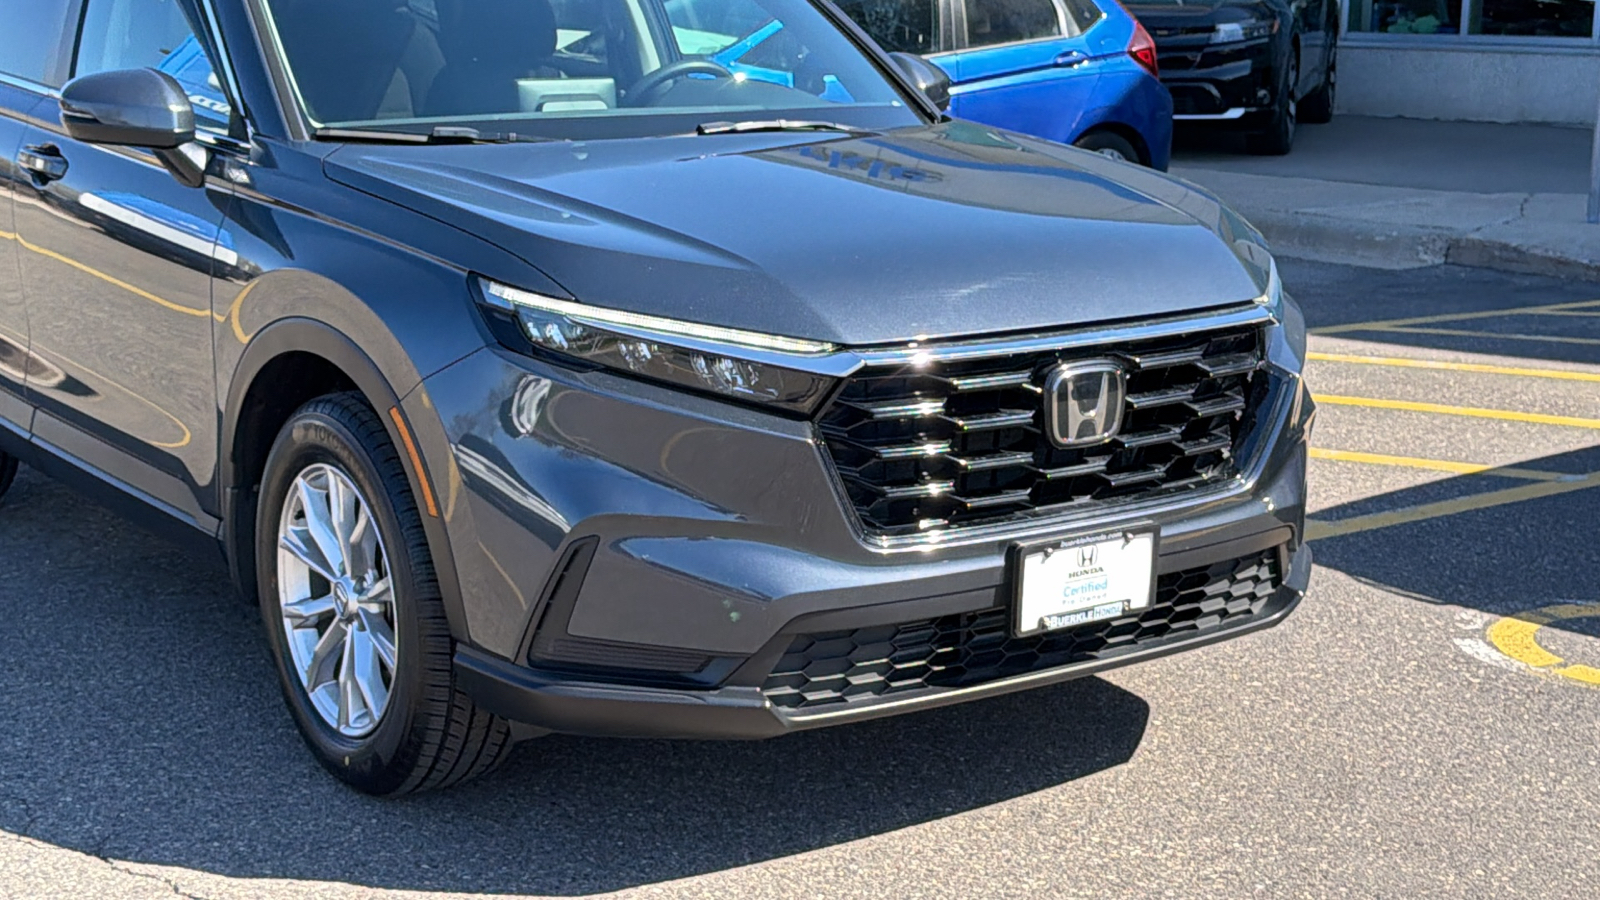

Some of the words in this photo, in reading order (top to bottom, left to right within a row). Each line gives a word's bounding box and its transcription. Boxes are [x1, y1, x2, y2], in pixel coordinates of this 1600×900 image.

[1068, 566, 1104, 579] HONDA
[1063, 578, 1108, 598] Certified
[1050, 609, 1094, 627] BUERKLE
[1094, 604, 1121, 617] HONDA
